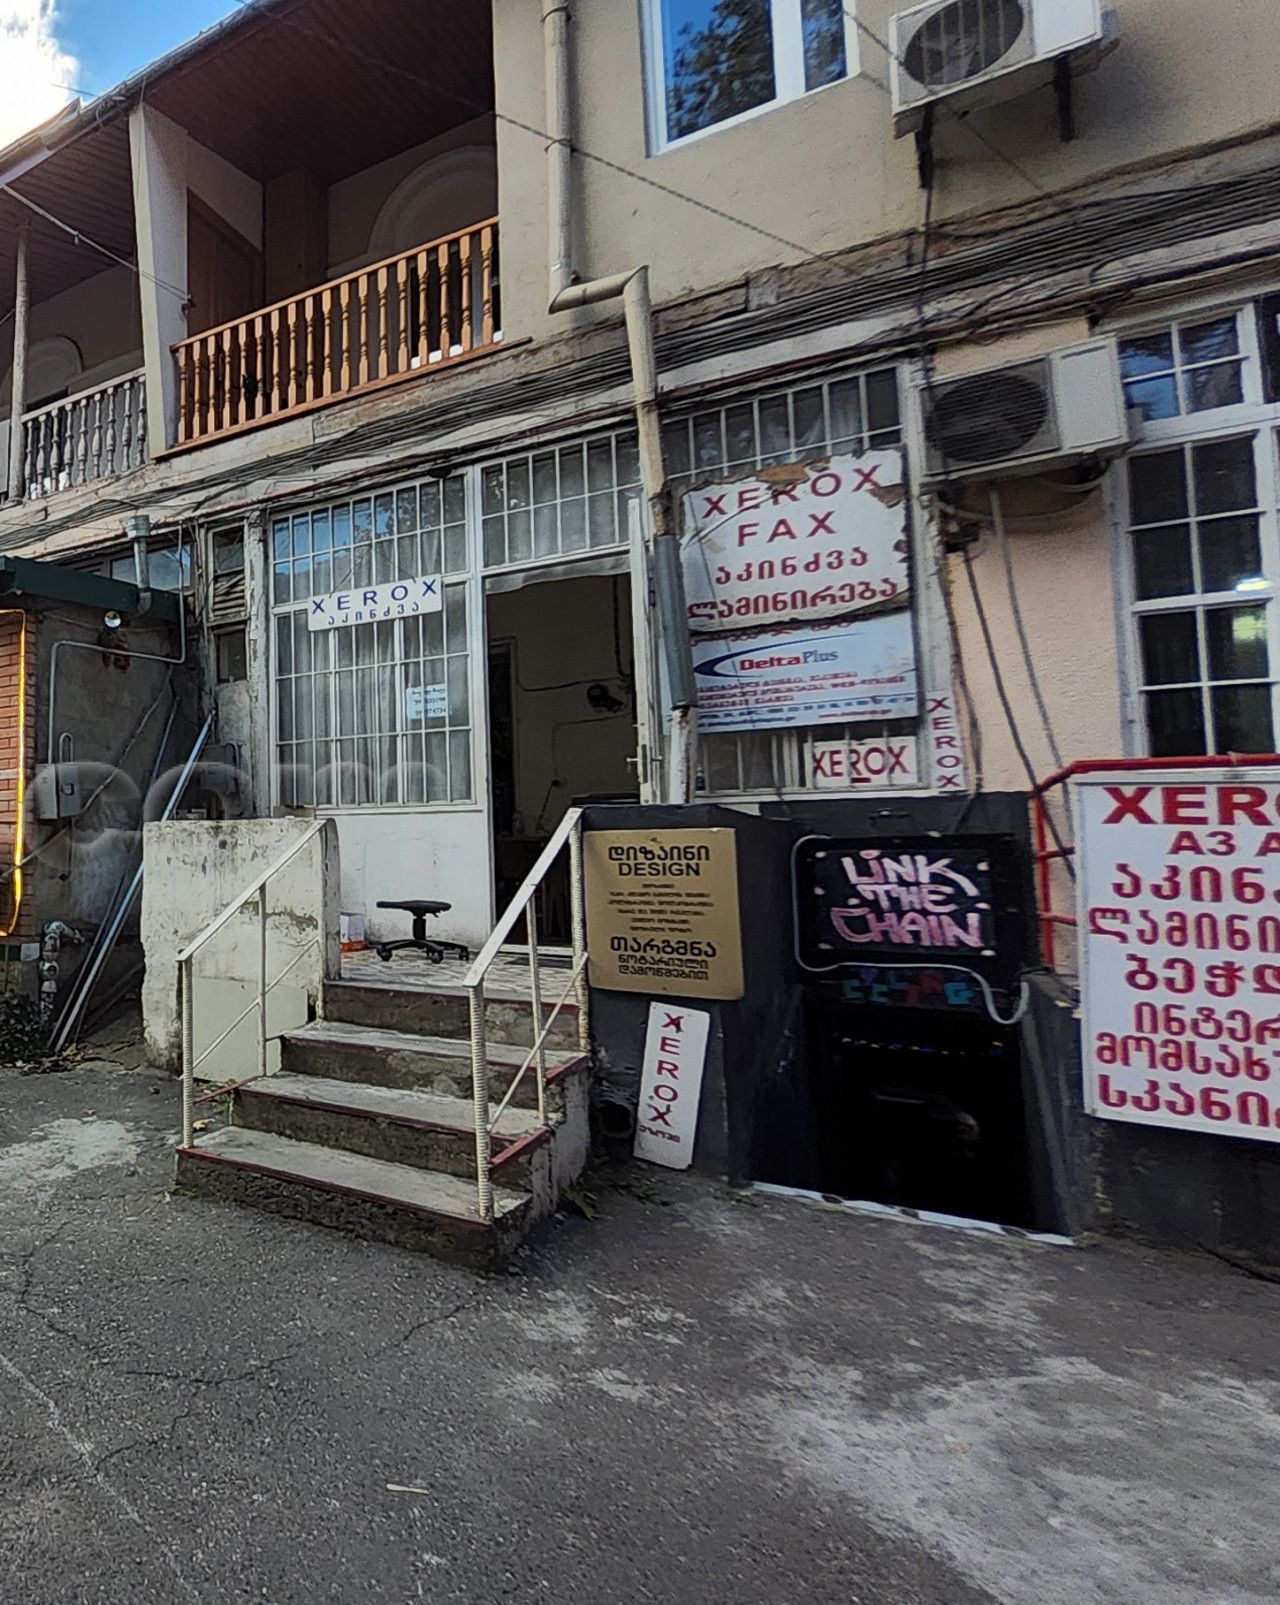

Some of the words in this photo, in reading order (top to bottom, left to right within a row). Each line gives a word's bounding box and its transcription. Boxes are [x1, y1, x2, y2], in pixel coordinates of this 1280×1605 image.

[702, 464, 881, 519] XEROX
[738, 510, 836, 547] FAX
[715, 546, 869, 585] აკინძვა
[312, 578, 437, 615] XEROX
[328, 601, 420, 626] აკინძვა
[687, 577, 899, 621] ლამინირება
[927, 696, 962, 788] XEROX
[812, 745, 909, 779] XEROX
[1102, 786, 1280, 826] XER
[608, 845, 711, 861] დიზაინი
[1167, 830, 1237, 857] A3
[618, 862, 701, 876] DESIGN
[1112, 863, 1280, 903] აკინ
[856, 884, 960, 913] THE
[830, 906, 986, 948] CHAIN
[610, 936, 717, 958] თარგმნა
[646, 1012, 685, 1128] XEROX
[1096, 1032, 1280, 1082] მომსახ
[1098, 1074, 1280, 1129] სკანი
